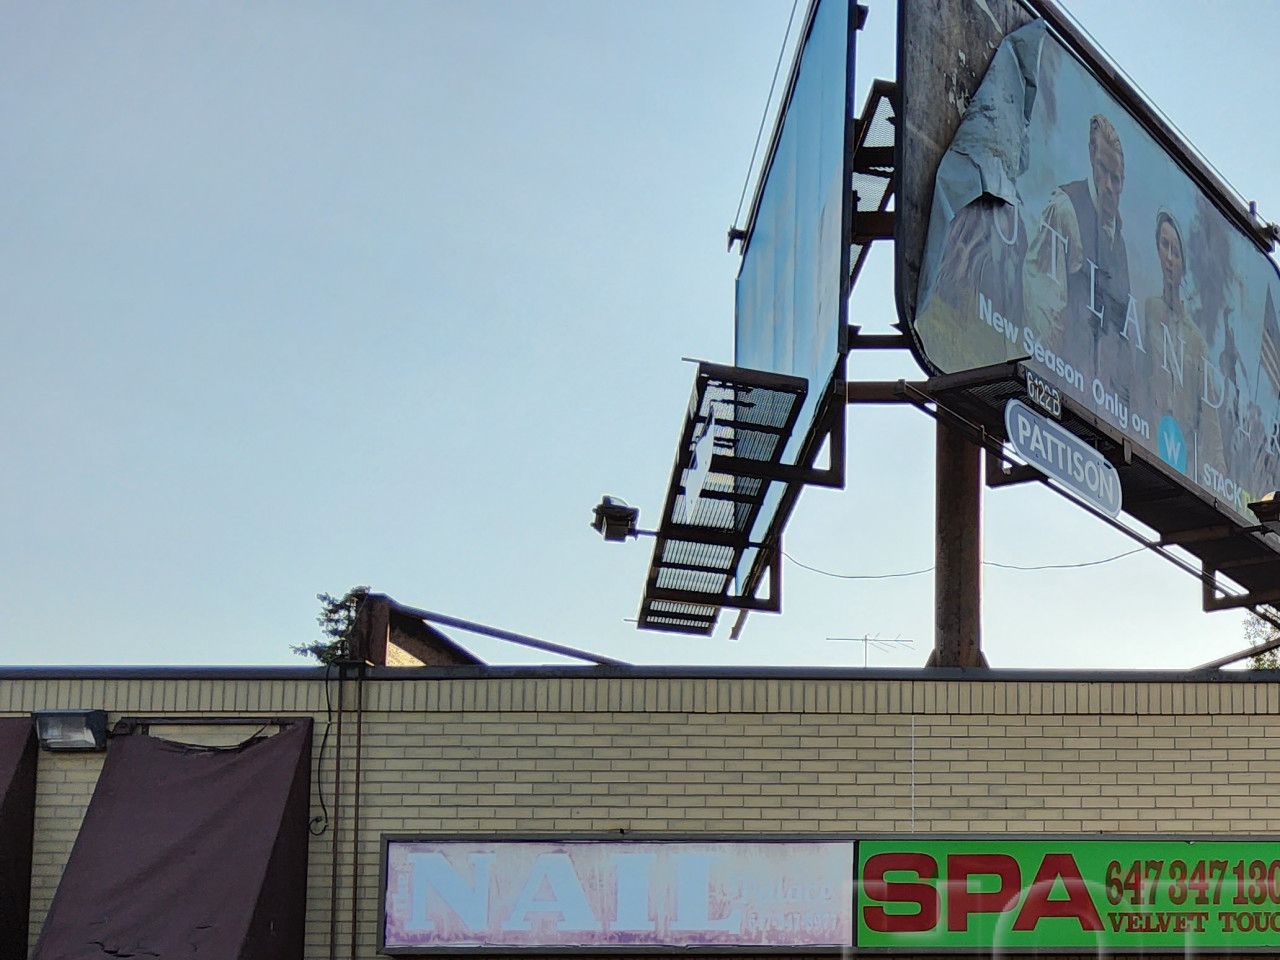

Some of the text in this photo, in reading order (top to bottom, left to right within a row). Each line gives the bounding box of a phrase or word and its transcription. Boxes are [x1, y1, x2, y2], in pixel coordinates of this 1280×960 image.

[979, 292, 1150, 440] New Season Only on
[1018, 413, 1114, 504] PATTISON
[863, 852, 1106, 933] SPA
[1105, 859, 1164, 906] 647
[1168, 859, 1229, 906] 347
[1110, 912, 1209, 933] VELVET
